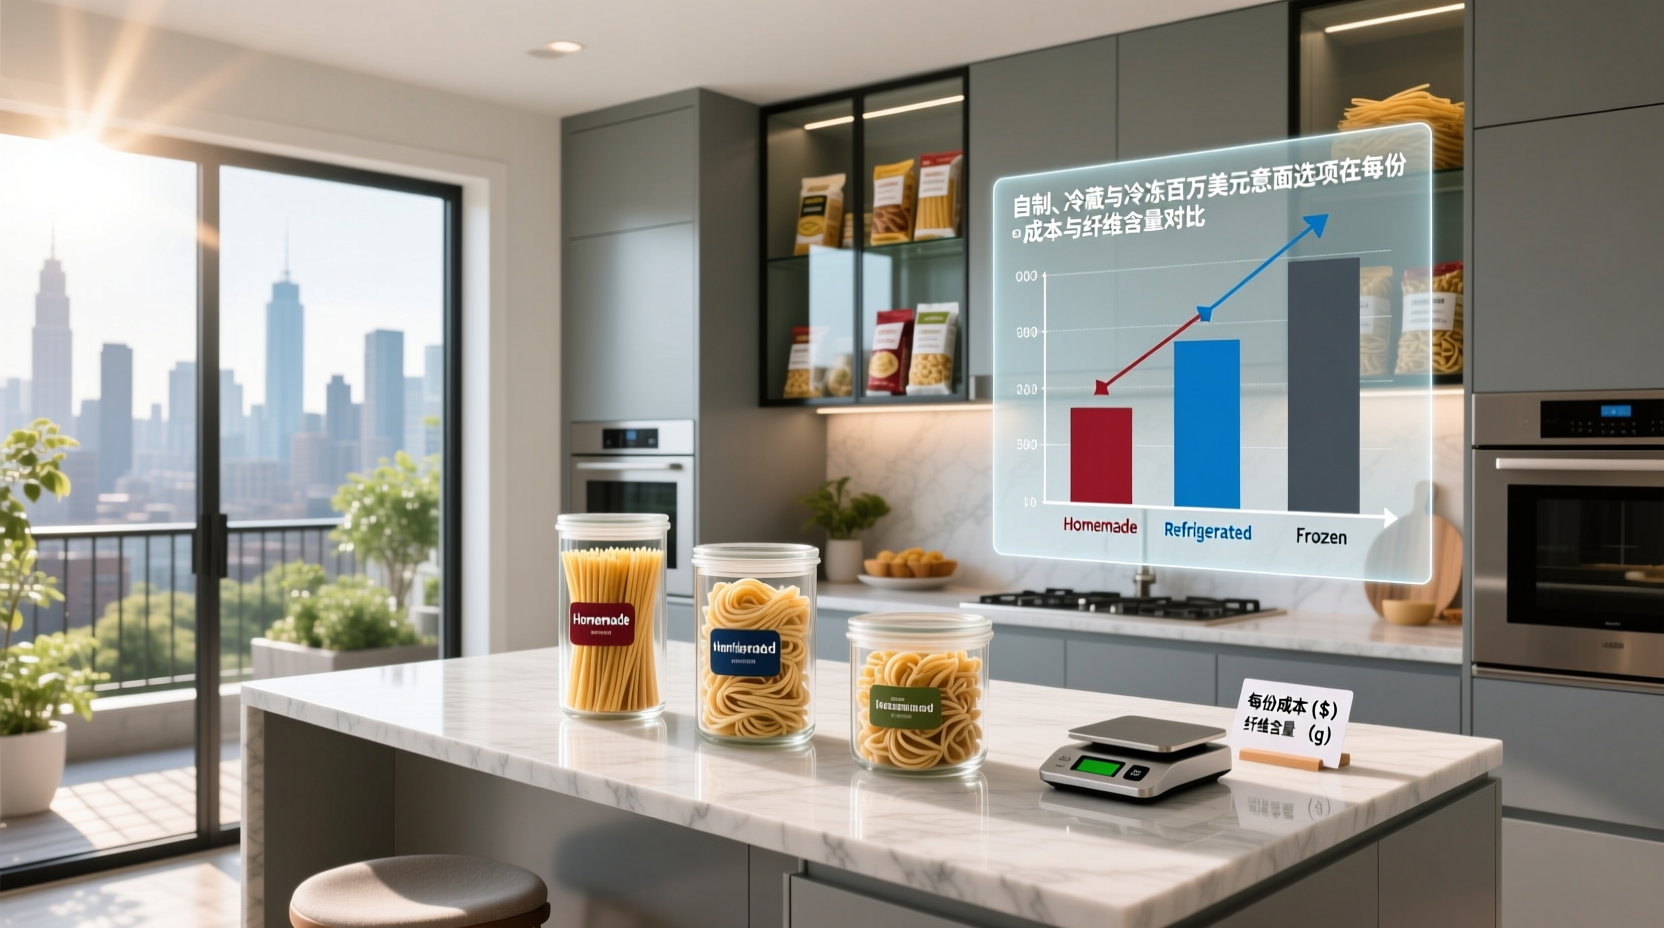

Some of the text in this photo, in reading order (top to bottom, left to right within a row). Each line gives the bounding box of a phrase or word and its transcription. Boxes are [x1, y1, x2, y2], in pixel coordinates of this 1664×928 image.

[1013, 151, 1407, 219] 自制、冷藏与冷冻百万美元意面选项在每份
[1063, 516, 1138, 534] Homemade
[1164, 521, 1252, 543] Refrigerated
[1296, 527, 1348, 546] Frozen
[1247, 691, 1308, 716] 每份成本
